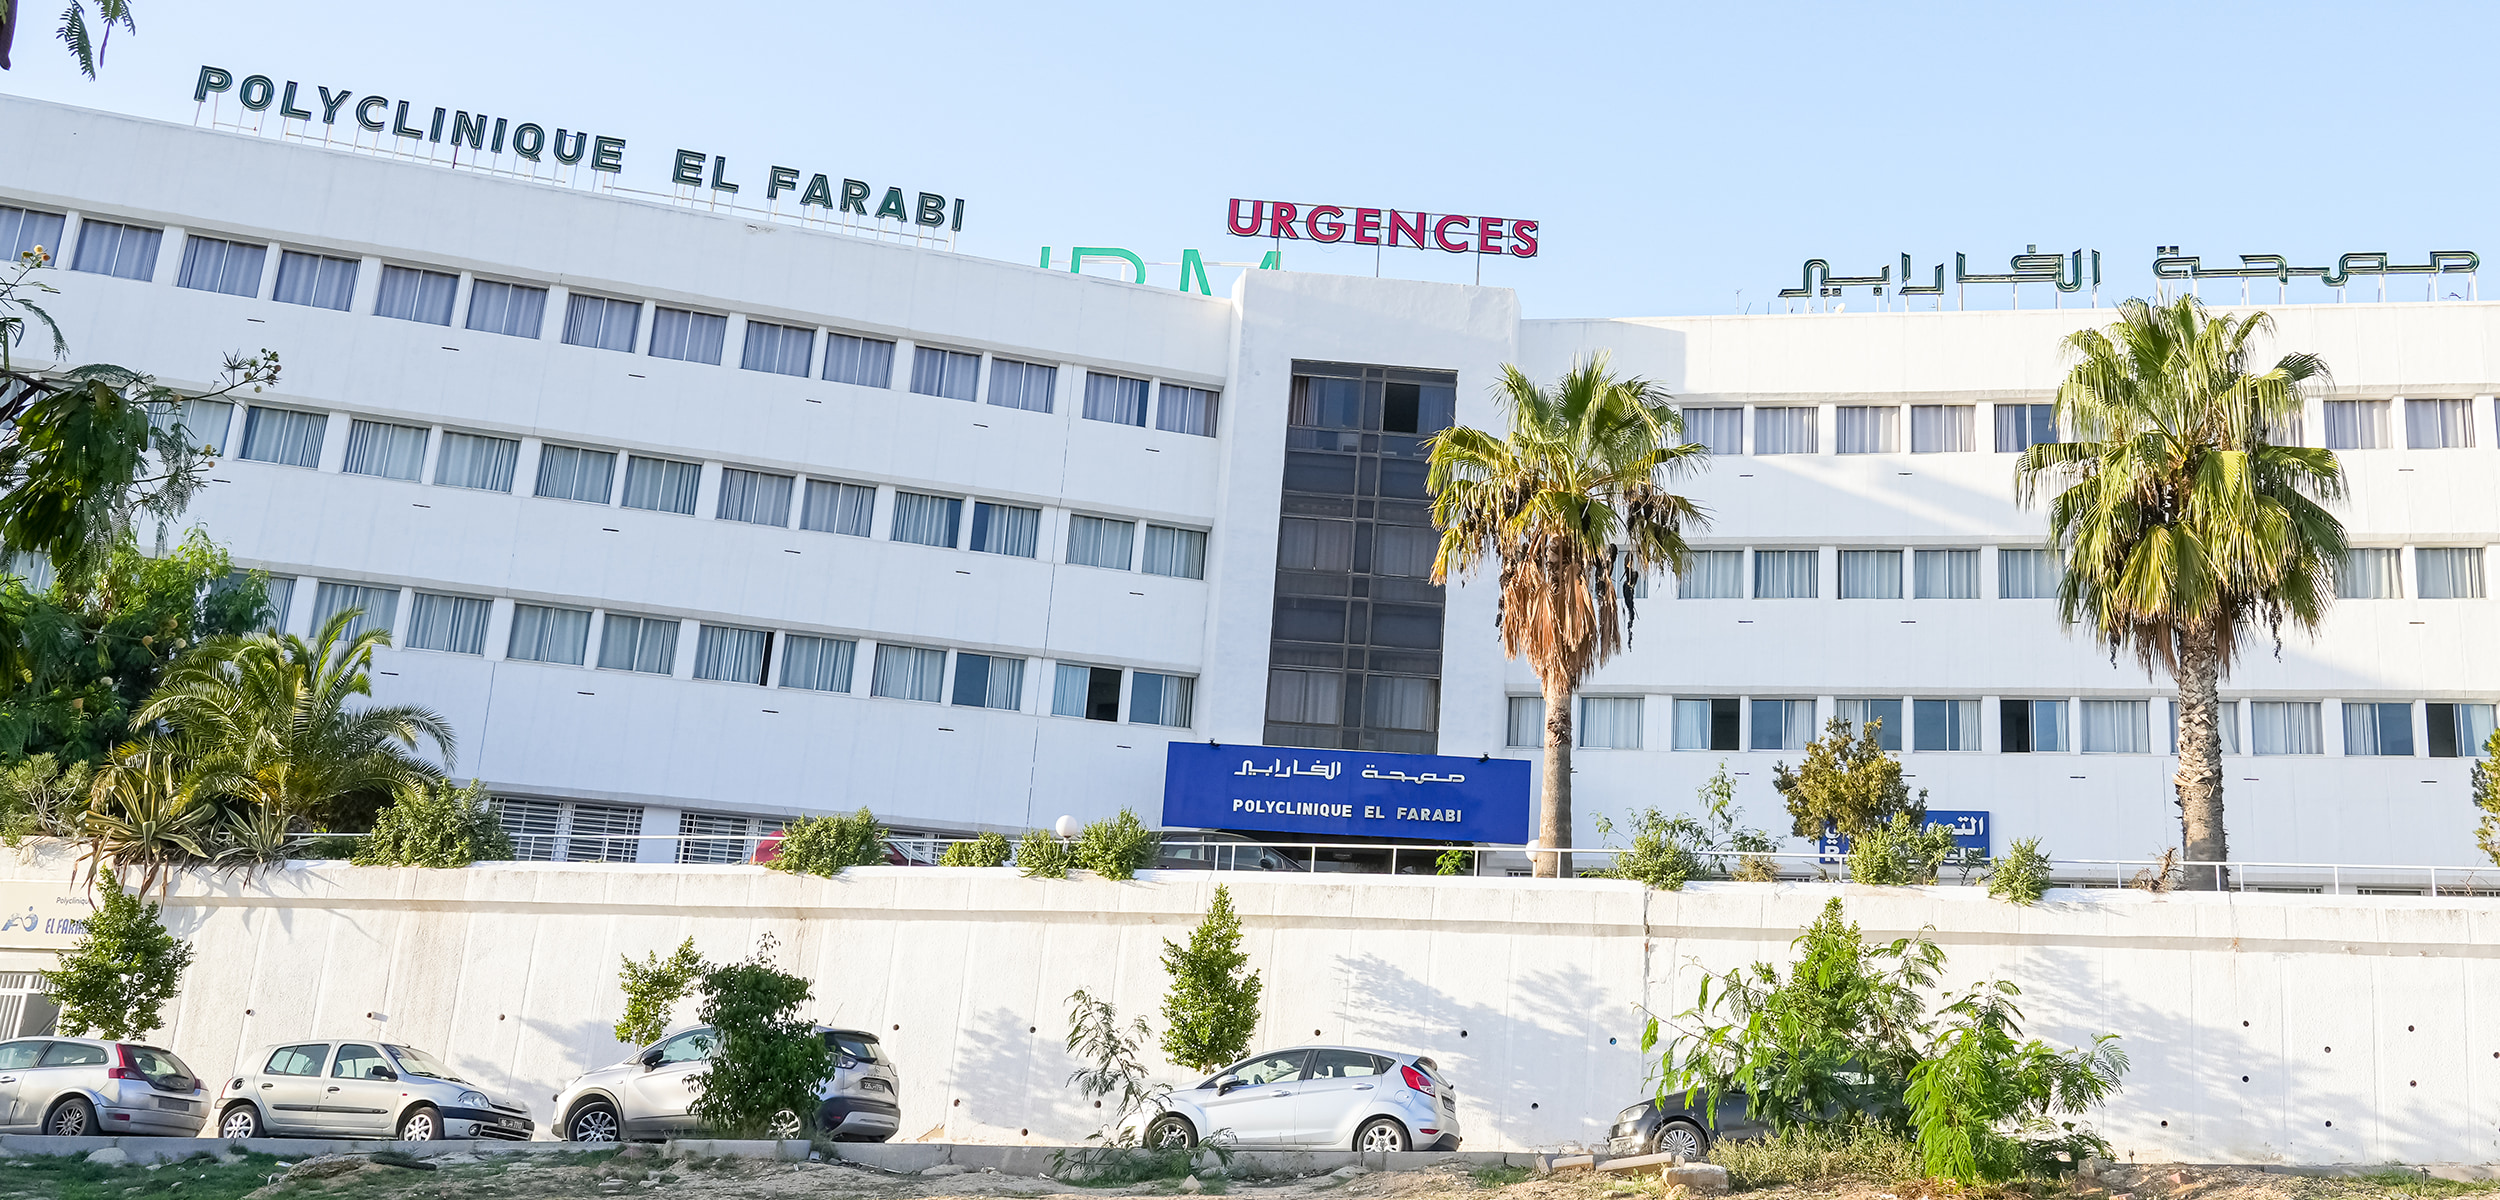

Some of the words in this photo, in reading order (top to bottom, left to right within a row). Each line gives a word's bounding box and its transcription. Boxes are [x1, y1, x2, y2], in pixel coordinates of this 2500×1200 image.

[193, 65, 626, 174] POLYCLINIQUE
[672, 148, 739, 194] EL
[766, 165, 965, 232] FARABI
[1226, 198, 1539, 258] URGENCES
[1233, 798, 1353, 818] POLYCLINIQUE
[1364, 805, 1385, 819] EL
[1397, 807, 1462, 823] FARABI
[56, 896, 92, 906] Polycliniqu
[45, 918, 55, 934] EL
